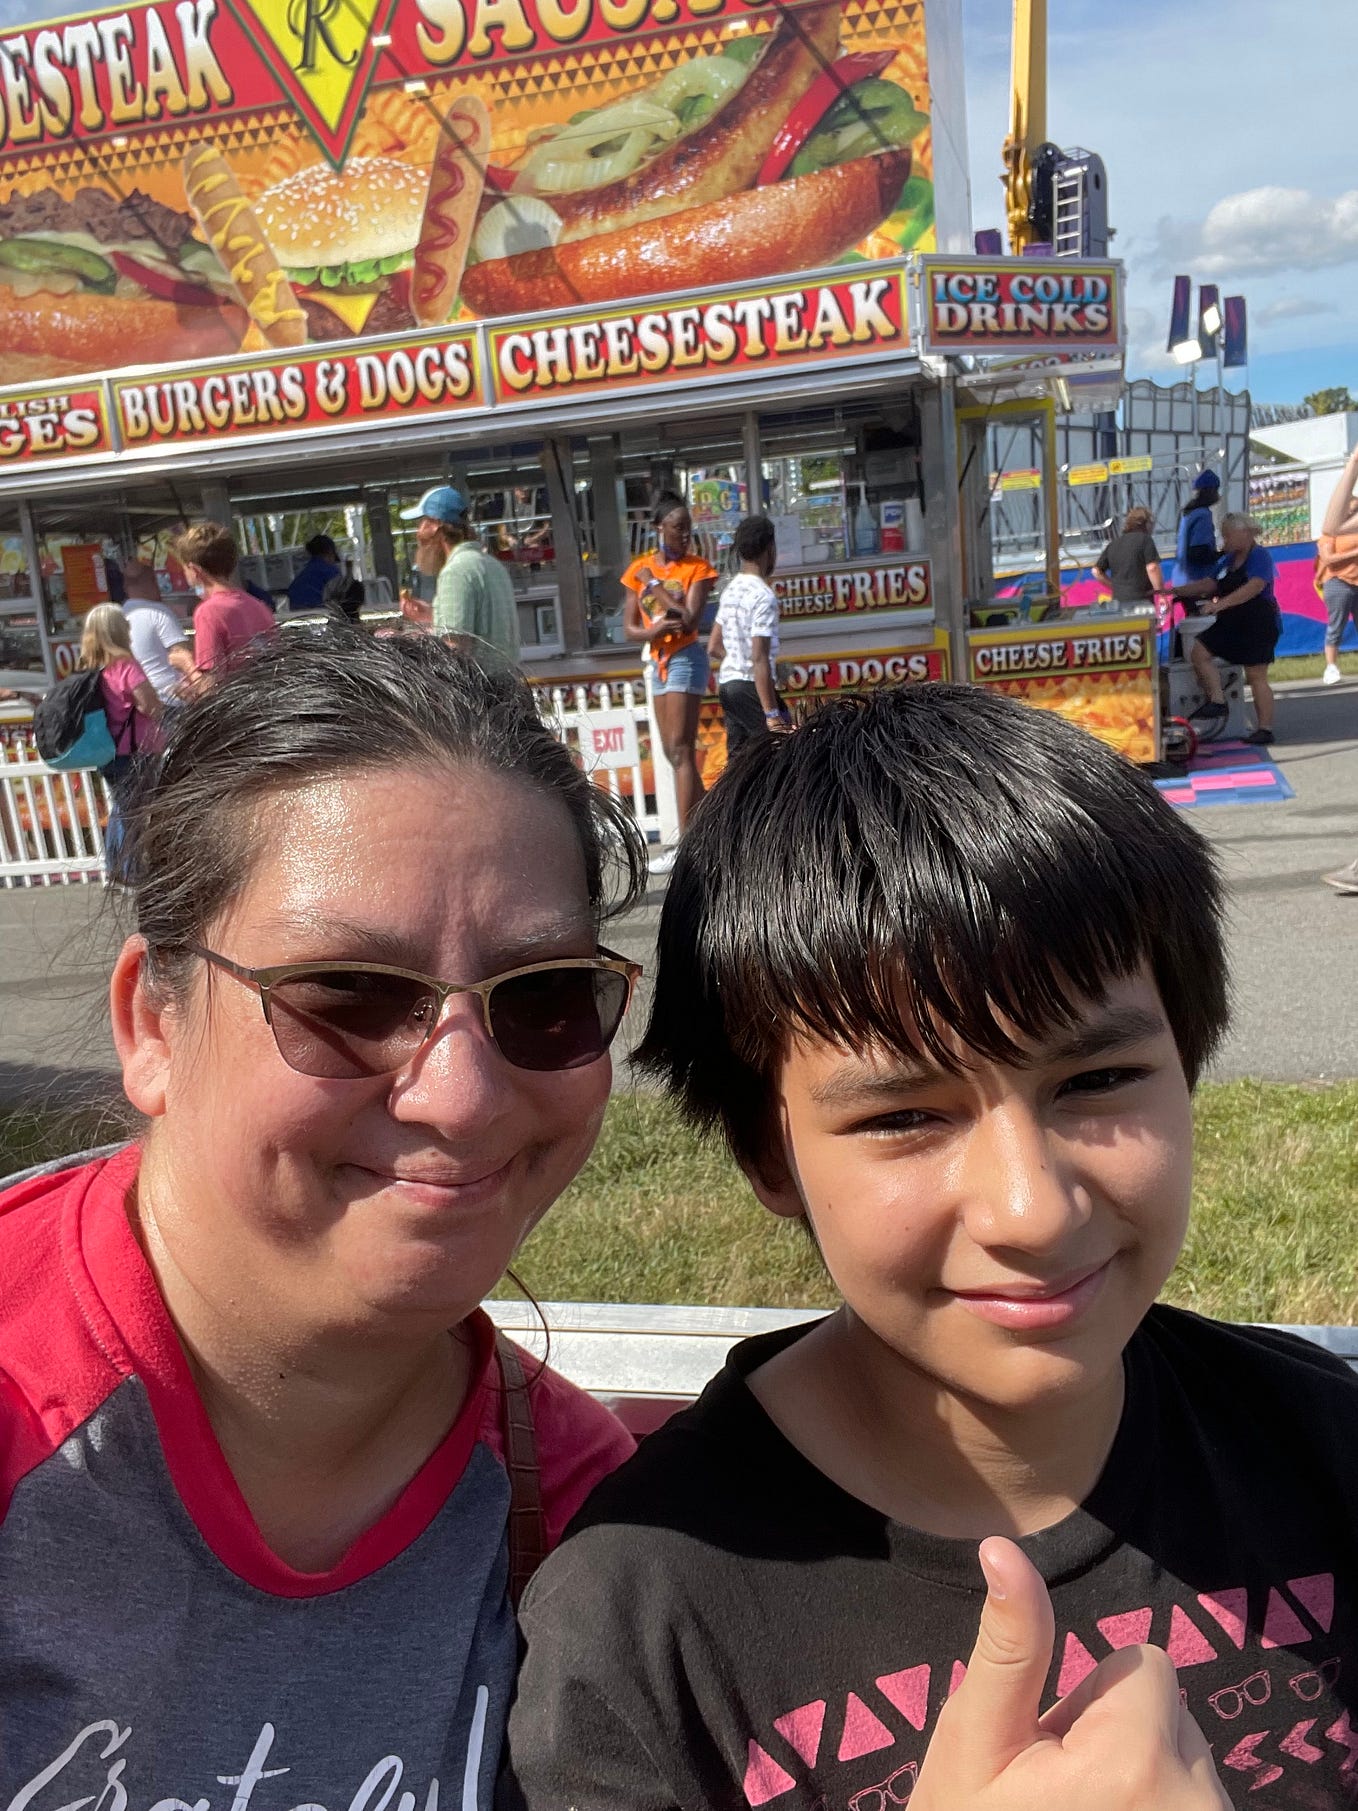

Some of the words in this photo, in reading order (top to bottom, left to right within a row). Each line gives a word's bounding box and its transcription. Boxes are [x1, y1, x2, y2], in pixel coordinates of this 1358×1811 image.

[0, 0, 233, 143] ESTEAK
[933, 274, 999, 301] ICE
[1010, 275, 1108, 301] COLD
[500, 279, 896, 390] CHEESESTEAK
[935, 303, 1109, 332] DRINKS
[121, 366, 306, 438] BURGERS
[316, 360, 346, 413] &
[355, 343, 471, 409] DOGS
[772, 574, 833, 597] CHILI
[834, 566, 927, 610] FRIES
[777, 594, 835, 615] HEESE
[976, 641, 1067, 673] CHEESE
[1073, 634, 1143, 665] FRIES
[775, 664, 829, 690] OT
[839, 656, 928, 686] DOGS
[593, 727, 624, 752] EXIT
